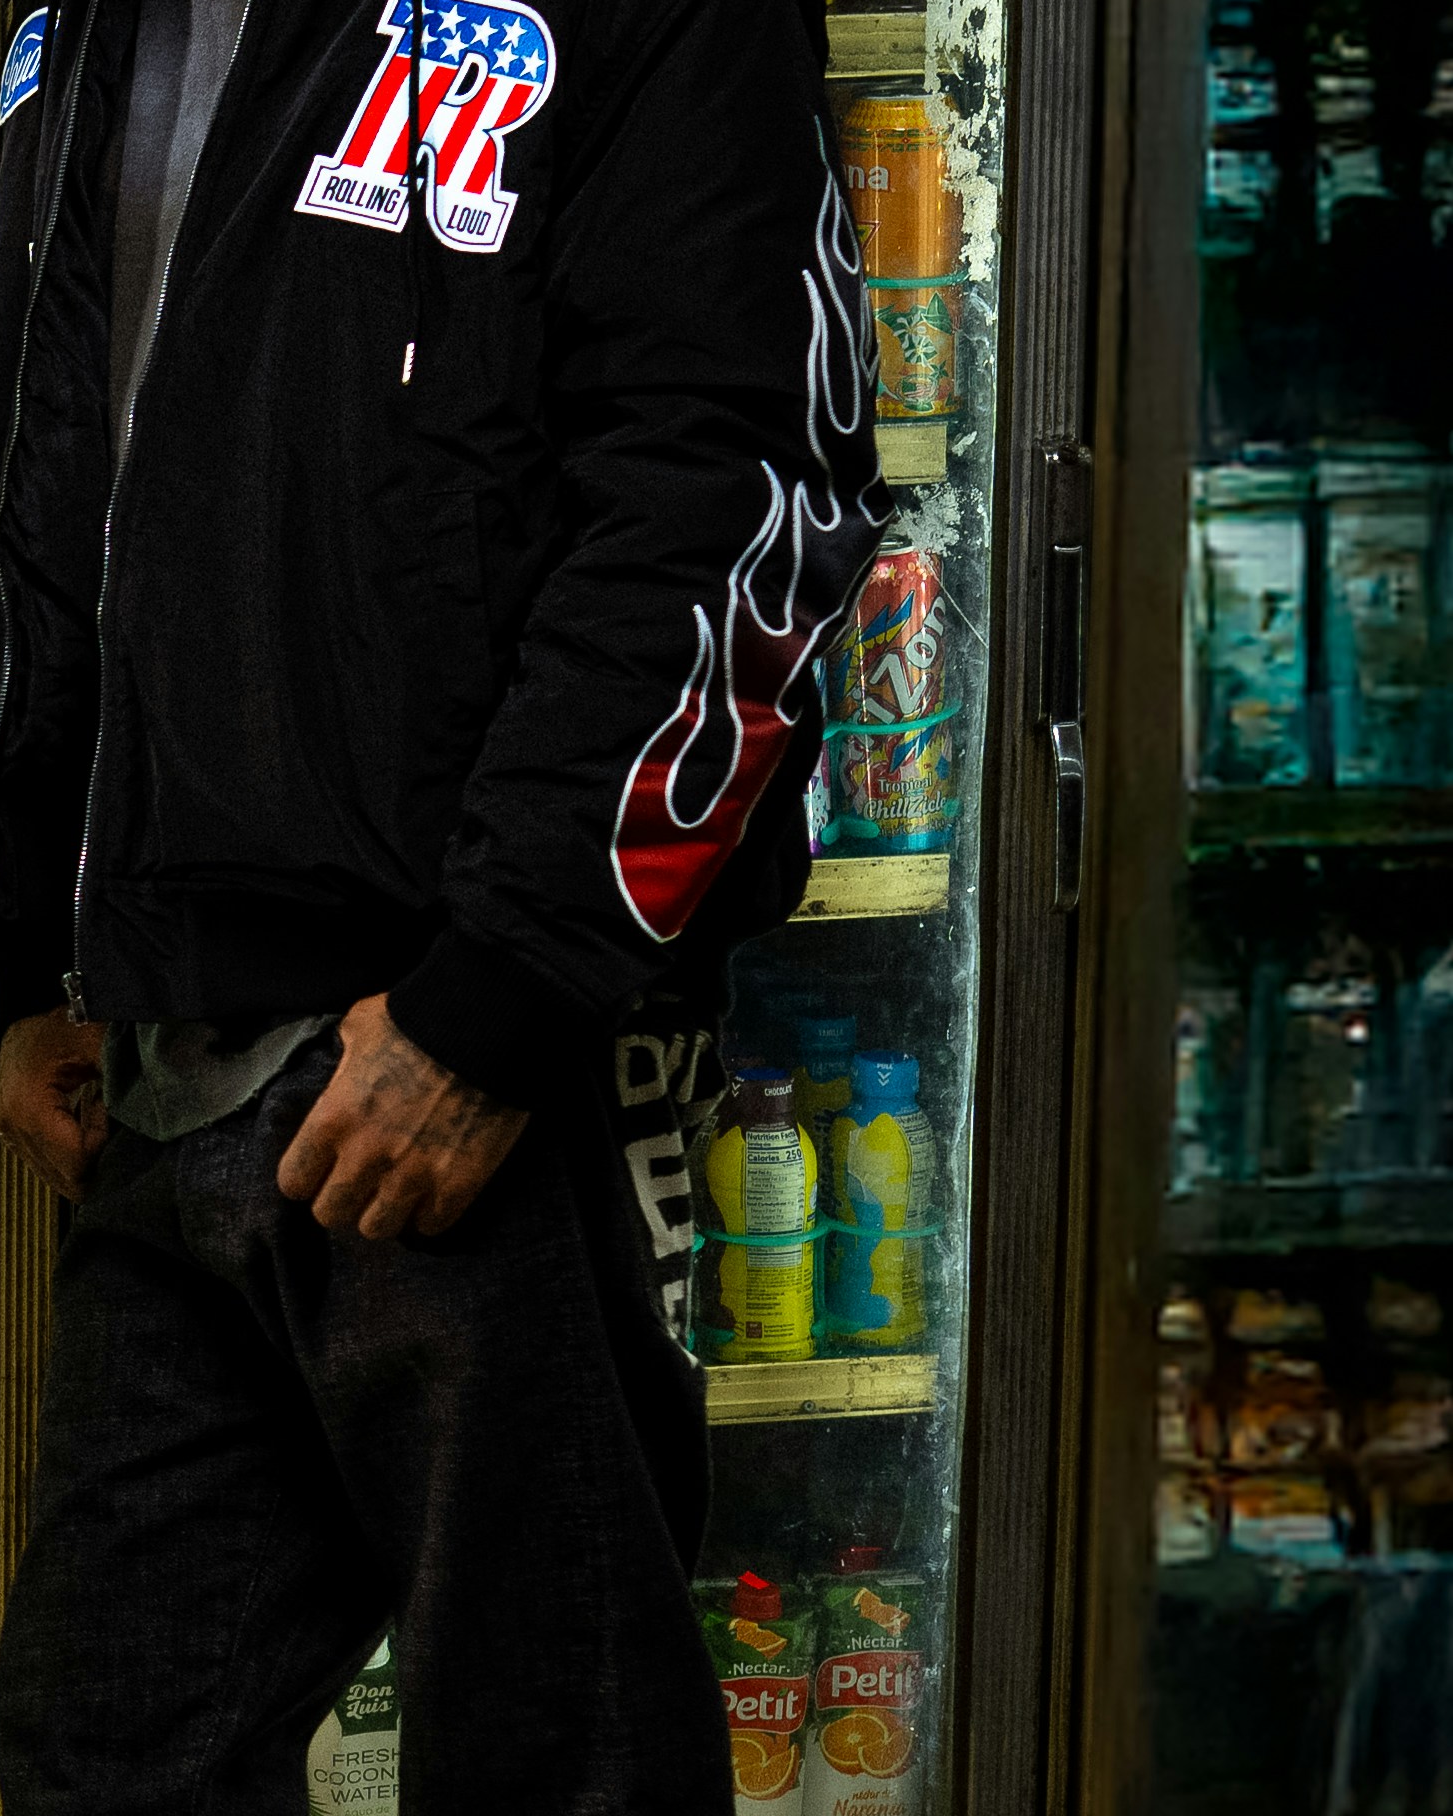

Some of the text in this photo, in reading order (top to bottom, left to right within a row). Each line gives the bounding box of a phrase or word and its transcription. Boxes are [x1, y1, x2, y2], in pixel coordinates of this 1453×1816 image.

[321, 174, 401, 215] ROLLING
[445, 204, 492, 237] LOUD
[877, 774, 935, 796] Tropical
[764, 1084, 793, 1097] CHOCOLATE
[747, 1149, 802, 1163] Calories 250
[732, 1662, 786, 1676] Nectar
[830, 1664, 918, 1698] Petit
[346, 1683, 395, 1702] Don
[346, 1697, 393, 1720] Luis
[375, 1805, 390, 1815] de
